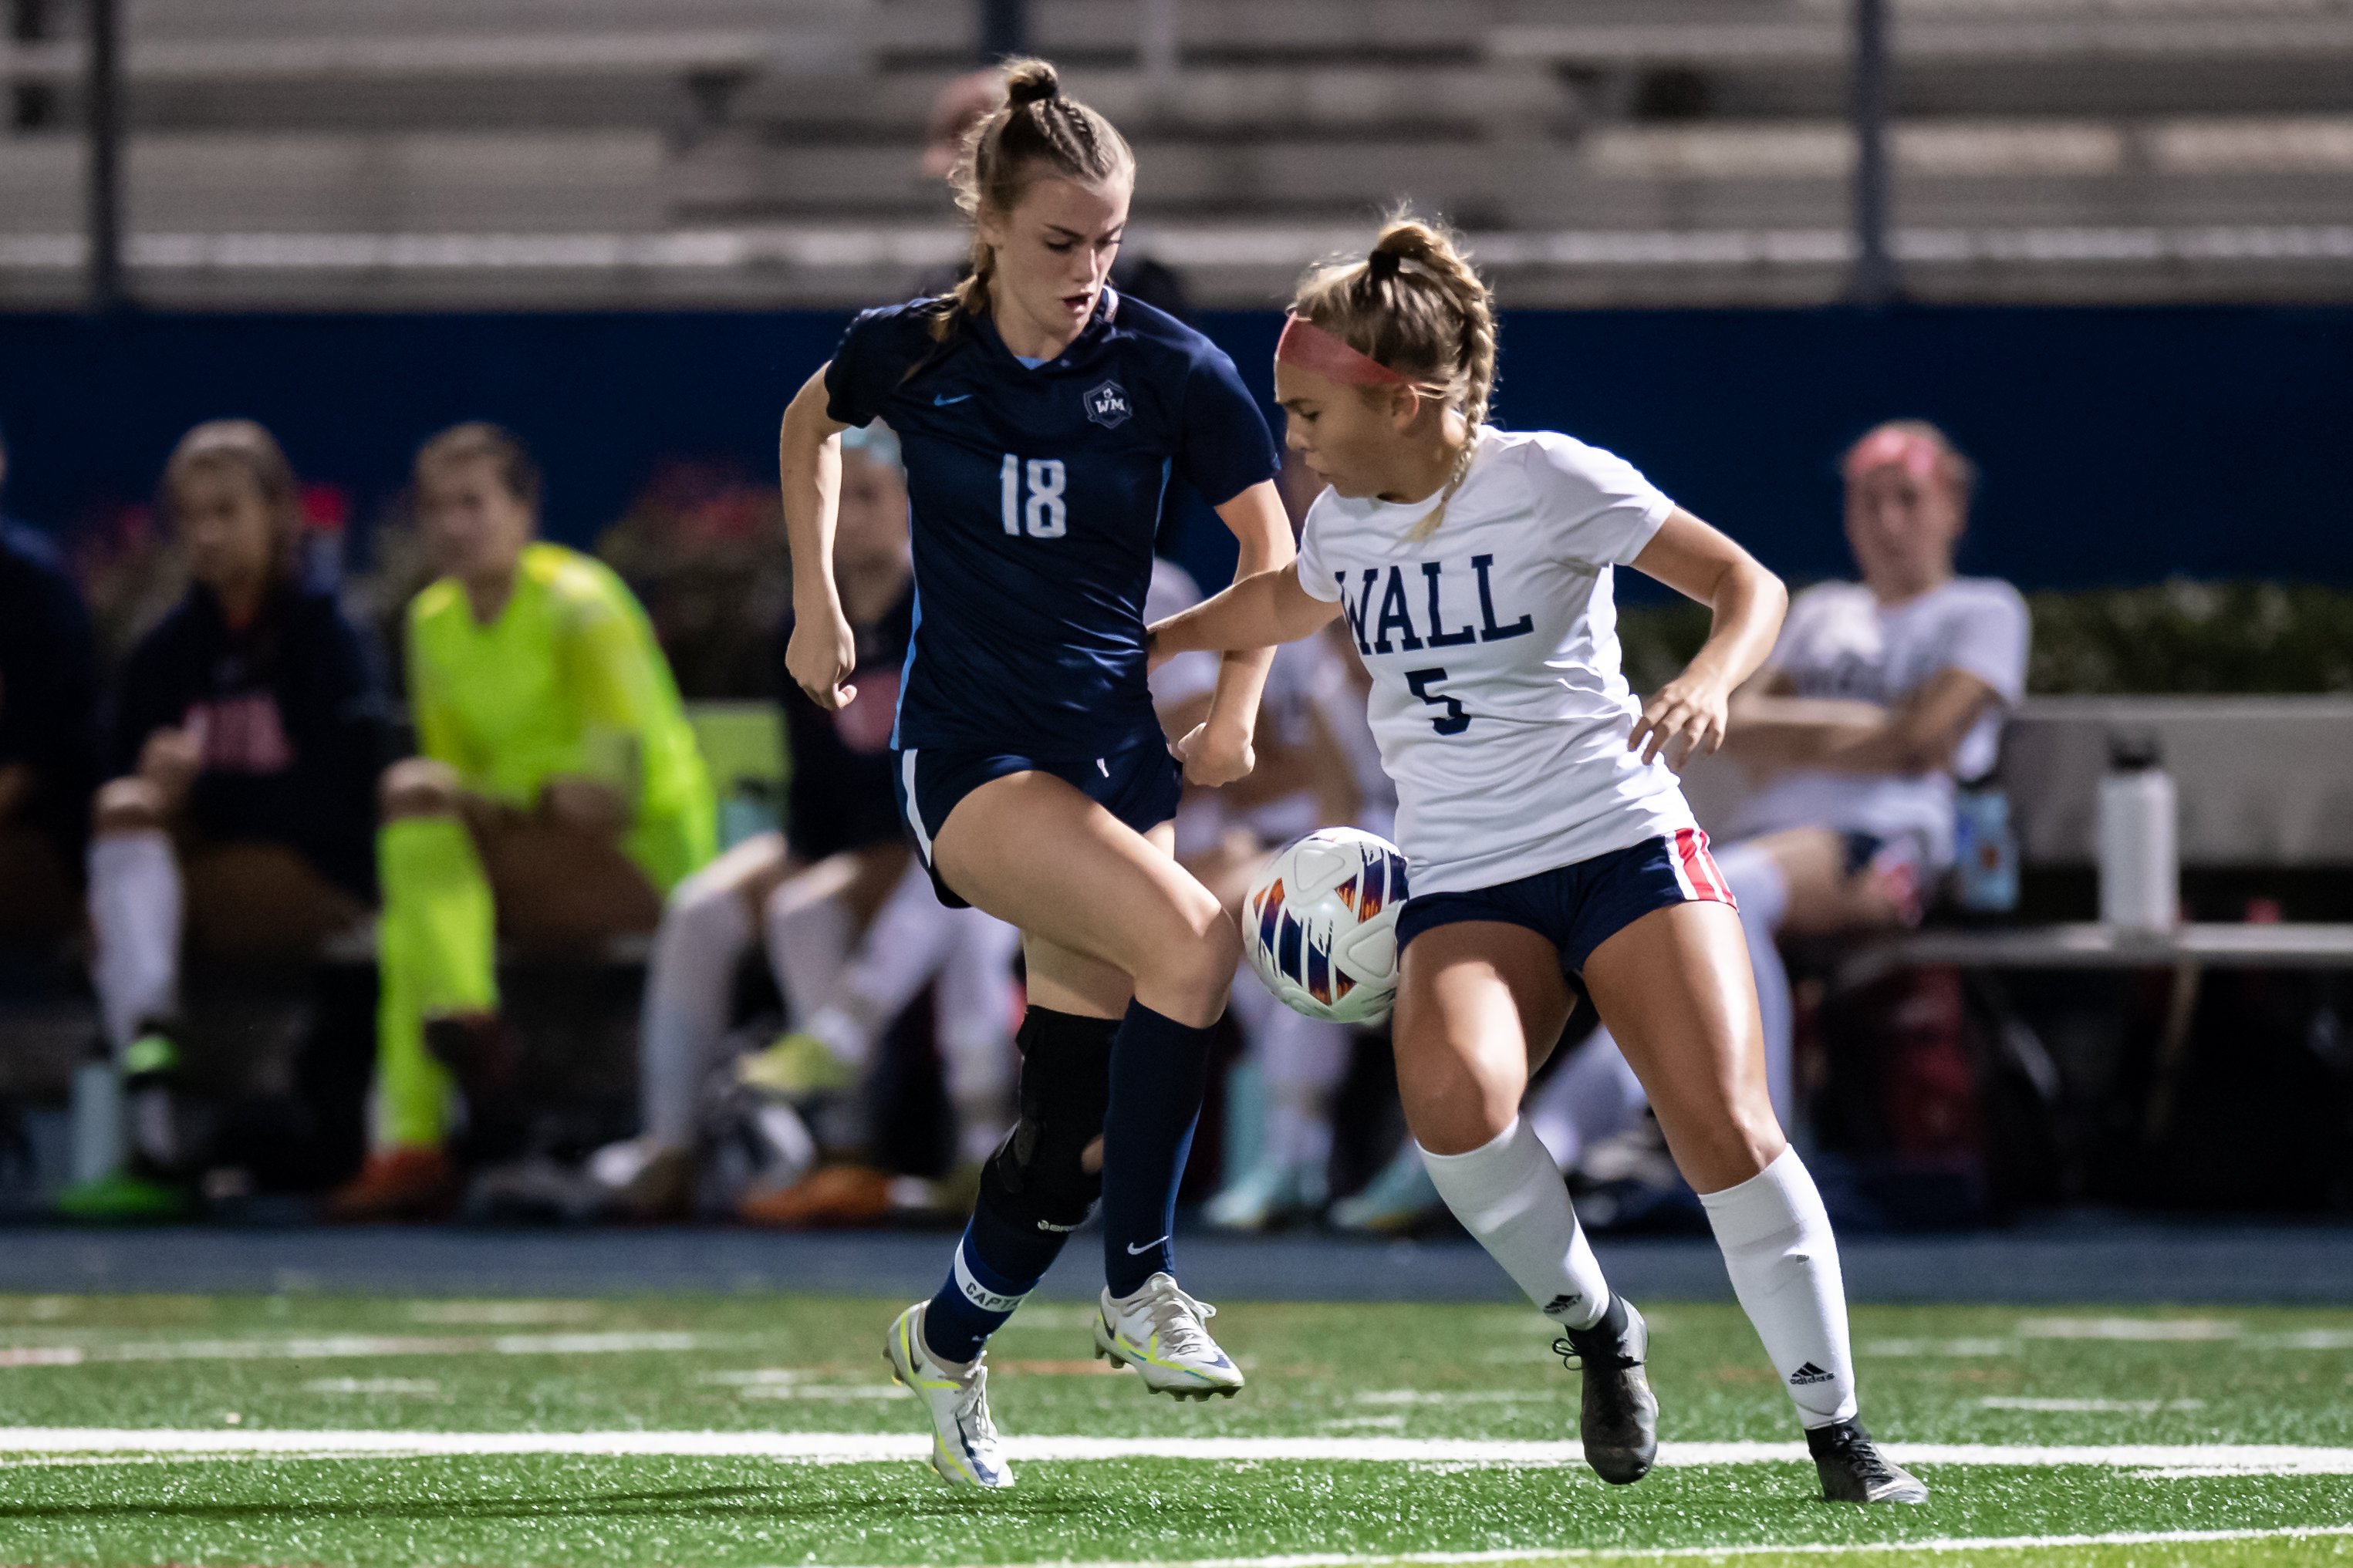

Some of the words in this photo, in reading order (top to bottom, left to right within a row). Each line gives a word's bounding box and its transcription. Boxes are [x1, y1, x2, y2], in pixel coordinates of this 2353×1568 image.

[1095, 398, 1126, 413] WM
[1000, 453, 1066, 538] 18
[1335, 553, 1534, 656] WALL
[1404, 667, 1471, 736] 5
[1789, 1373, 1835, 1385] adidas
